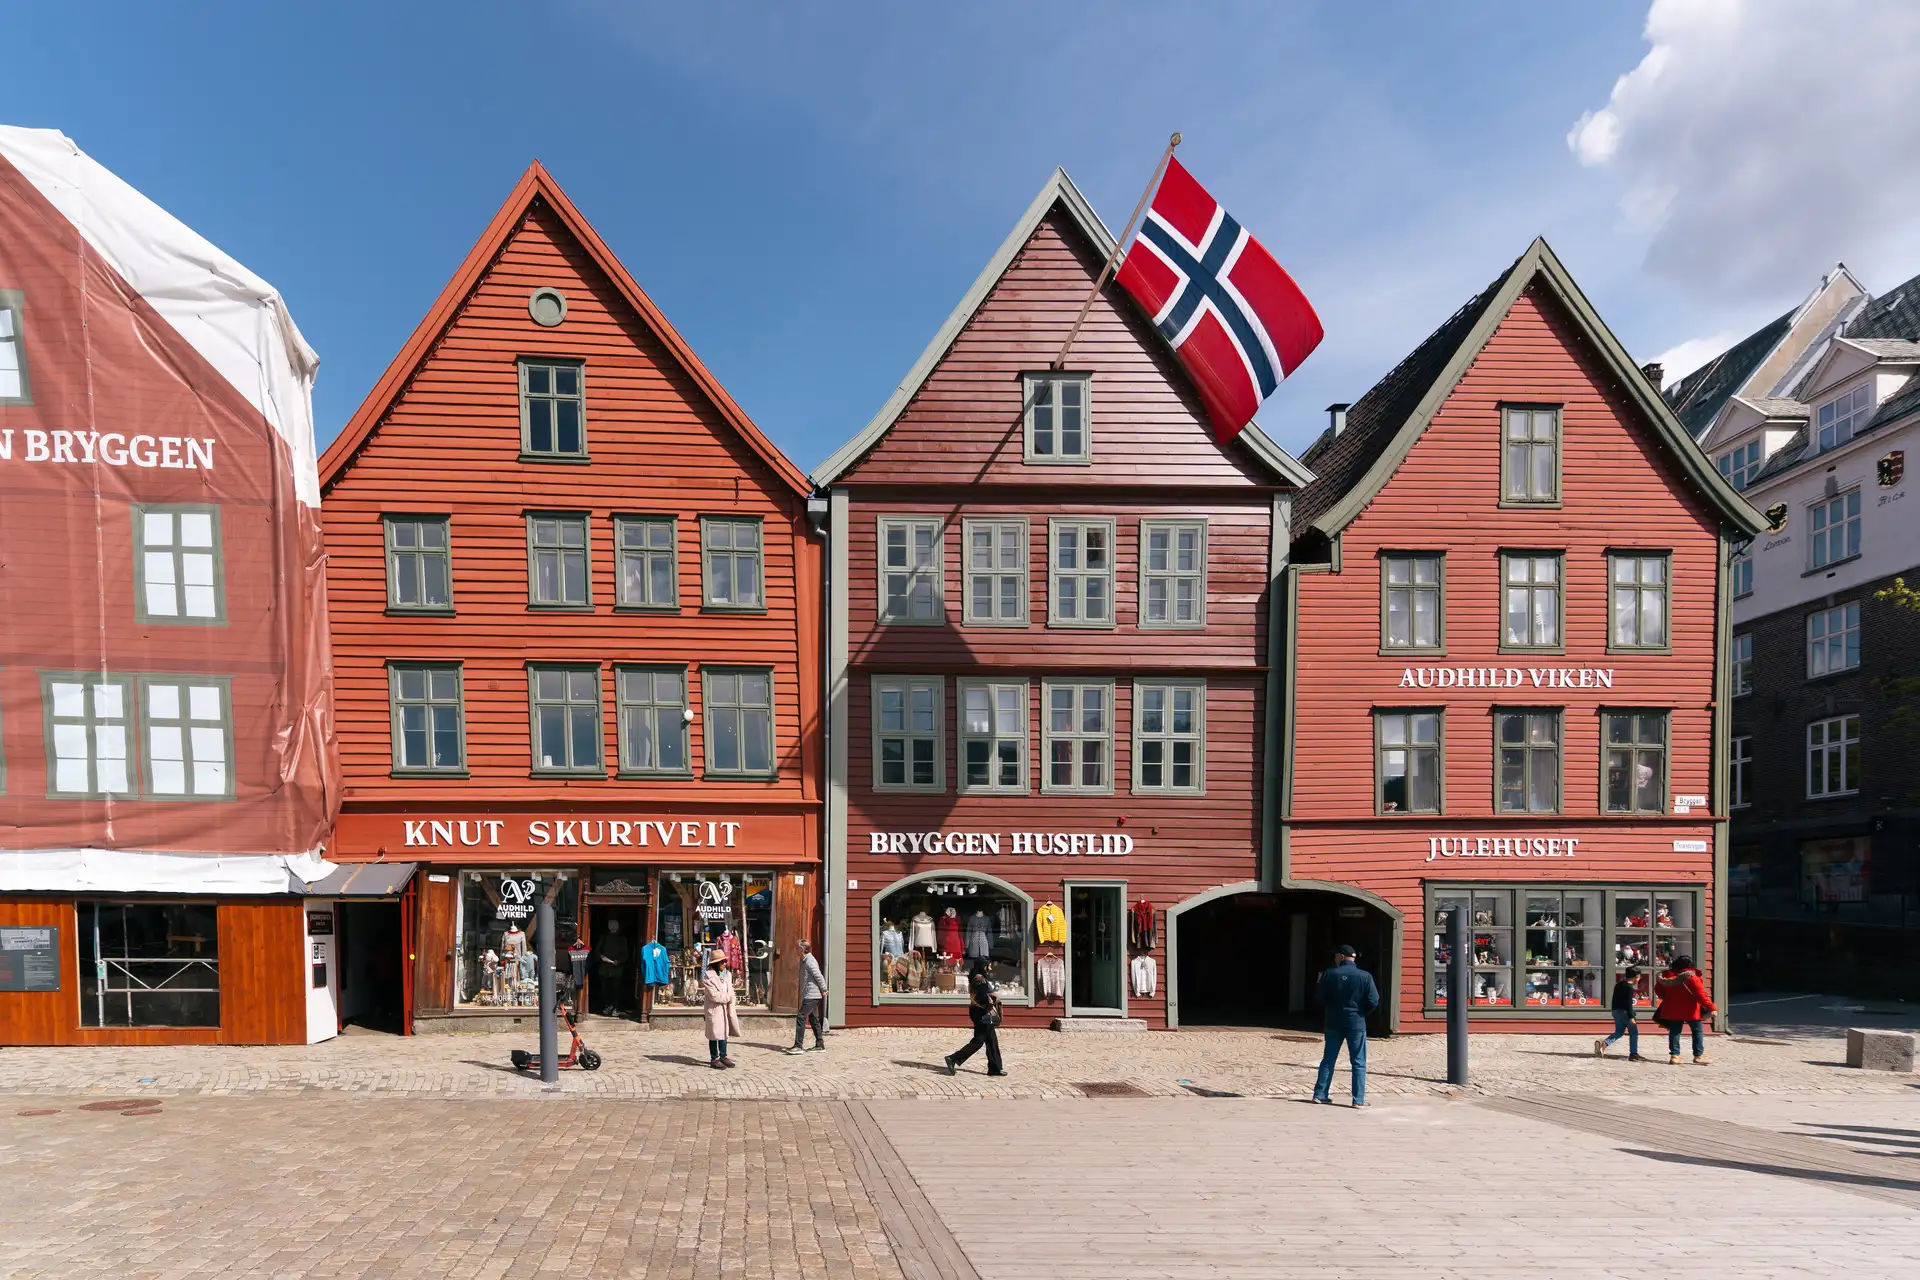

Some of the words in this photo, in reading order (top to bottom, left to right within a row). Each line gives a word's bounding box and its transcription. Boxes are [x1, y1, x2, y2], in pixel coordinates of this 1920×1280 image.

[24, 429, 215, 469] BRYGGEN
[1398, 667, 1523, 688] AUDHILD
[1529, 668, 1614, 689] VIKEN
[403, 820, 505, 847] KNUT
[528, 820, 741, 848] SKURTVEIT
[869, 832, 1001, 855] BRYGGEN
[1011, 832, 1134, 857] HUSFLID
[1425, 837, 1579, 862] JULEHUSET
[497, 904, 535, 912] AUDHILD
[502, 911, 527, 919] VIKEN
[695, 905, 731, 913] AUDHILD
